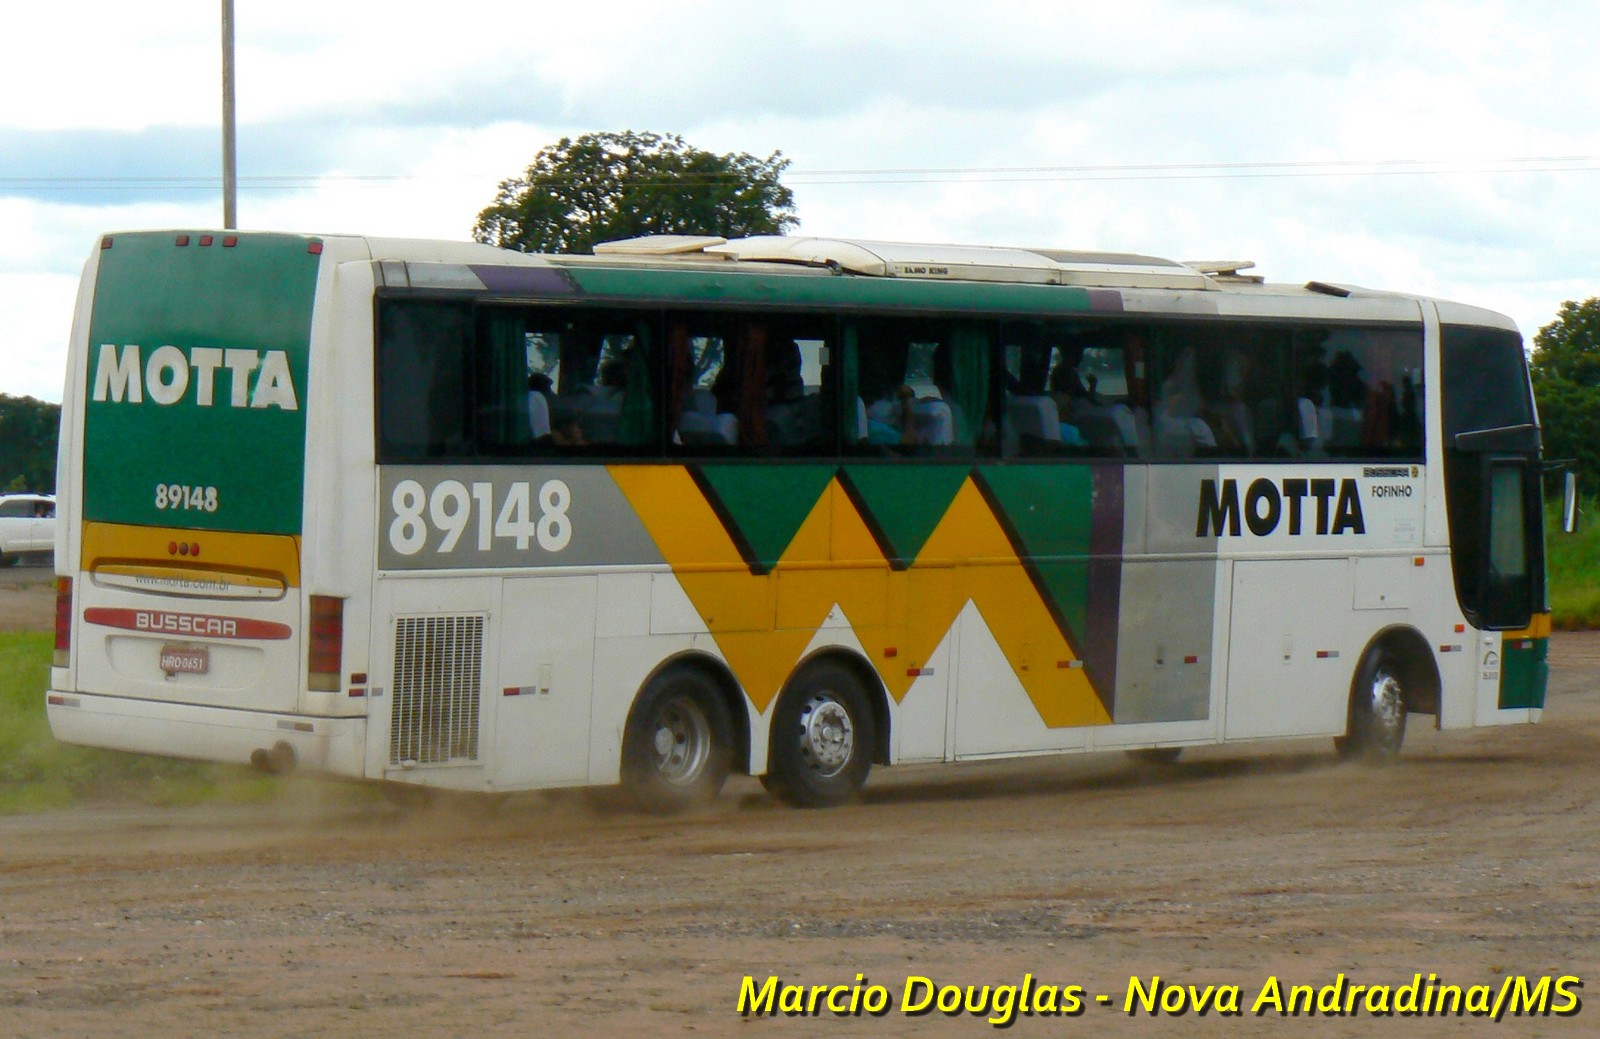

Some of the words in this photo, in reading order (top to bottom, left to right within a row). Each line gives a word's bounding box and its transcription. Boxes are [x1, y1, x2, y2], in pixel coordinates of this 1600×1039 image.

[93, 343, 299, 411] MOTTA
[155, 483, 218, 512] 89148
[1196, 477, 1366, 537] MOTTA
[1371, 485, 1412, 498] FOFINHO
[389, 479, 572, 555] 89148
[136, 612, 237, 636] BUSSCAR
